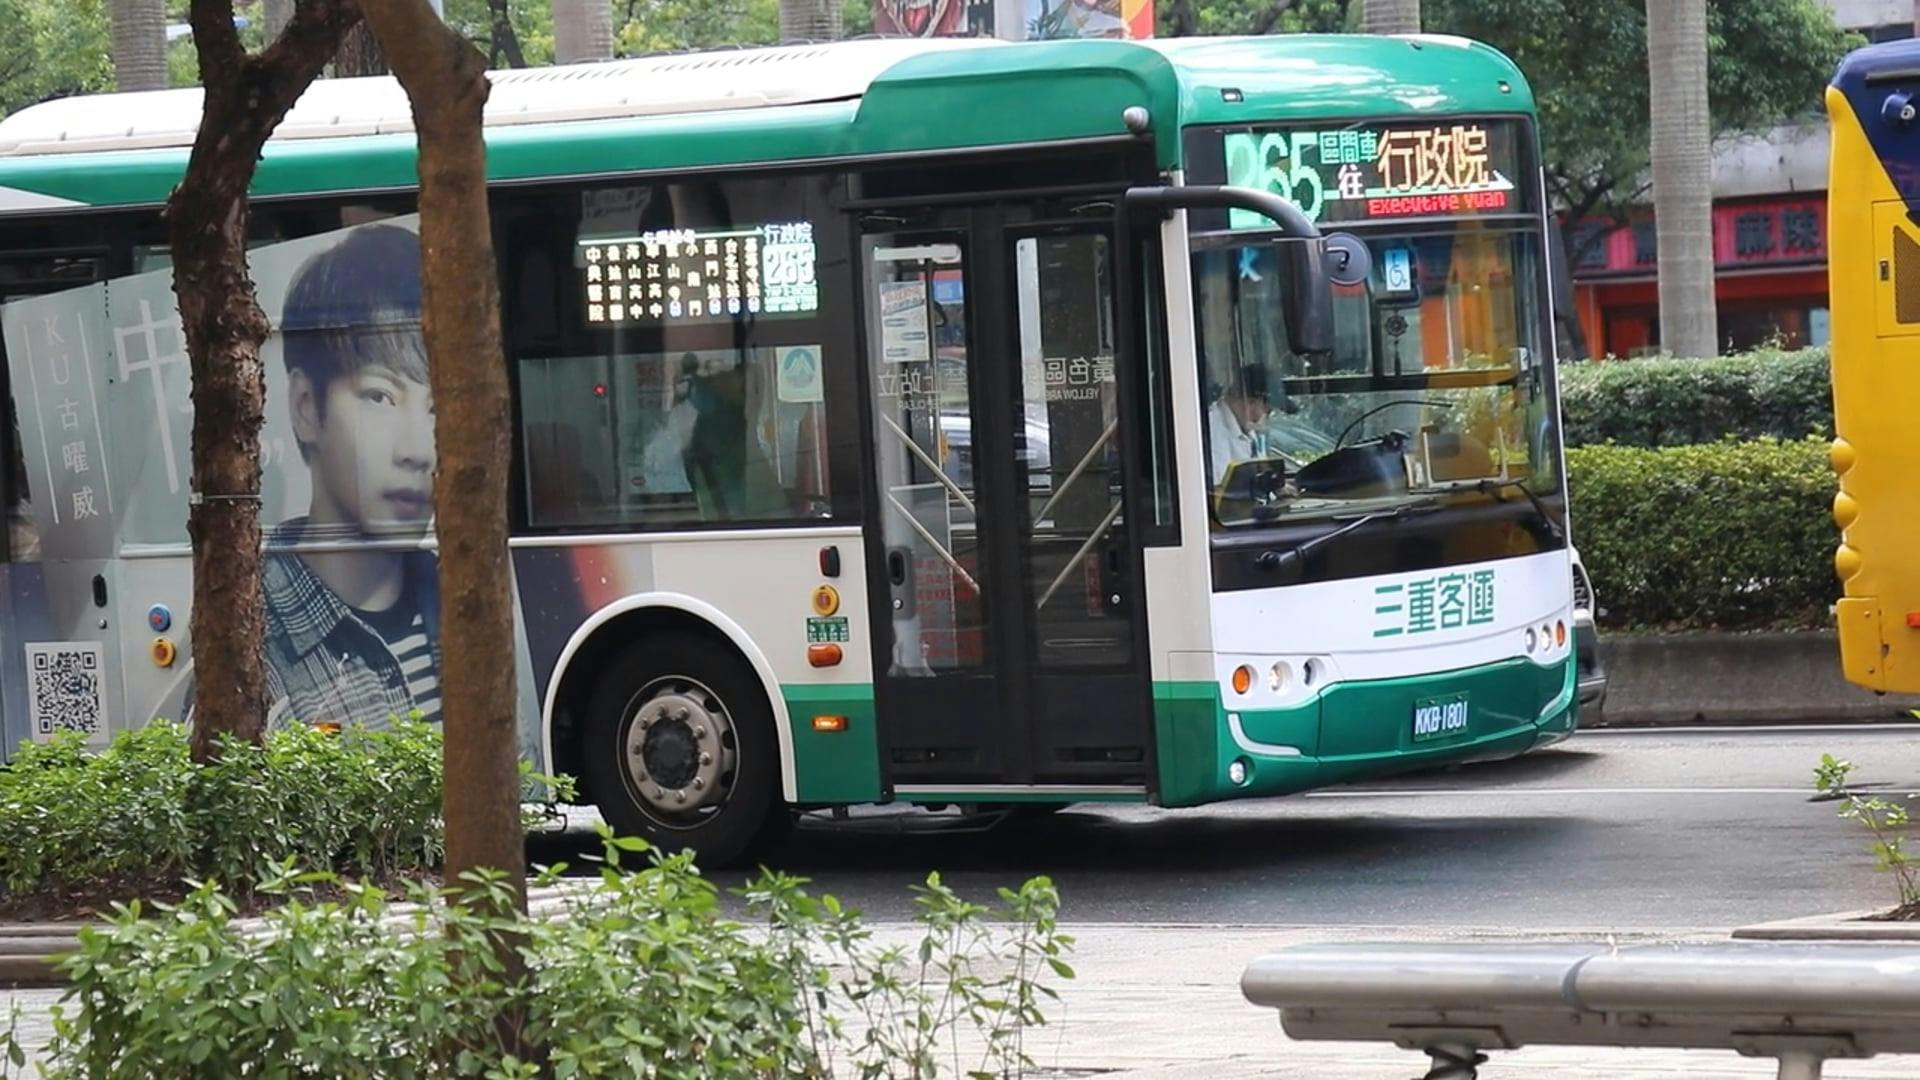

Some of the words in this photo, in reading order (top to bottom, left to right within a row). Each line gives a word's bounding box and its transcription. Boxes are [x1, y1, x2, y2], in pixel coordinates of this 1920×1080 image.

[1319, 130, 1378, 165] 區間車
[1378, 125, 1488, 192] 行政院
[1338, 164, 1363, 199] 往
[763, 221, 813, 244] 行政院
[762, 243, 816, 288] 265
[1373, 568, 1495, 638] 三重客運
[1415, 700, 1468, 736] KKB-1801
